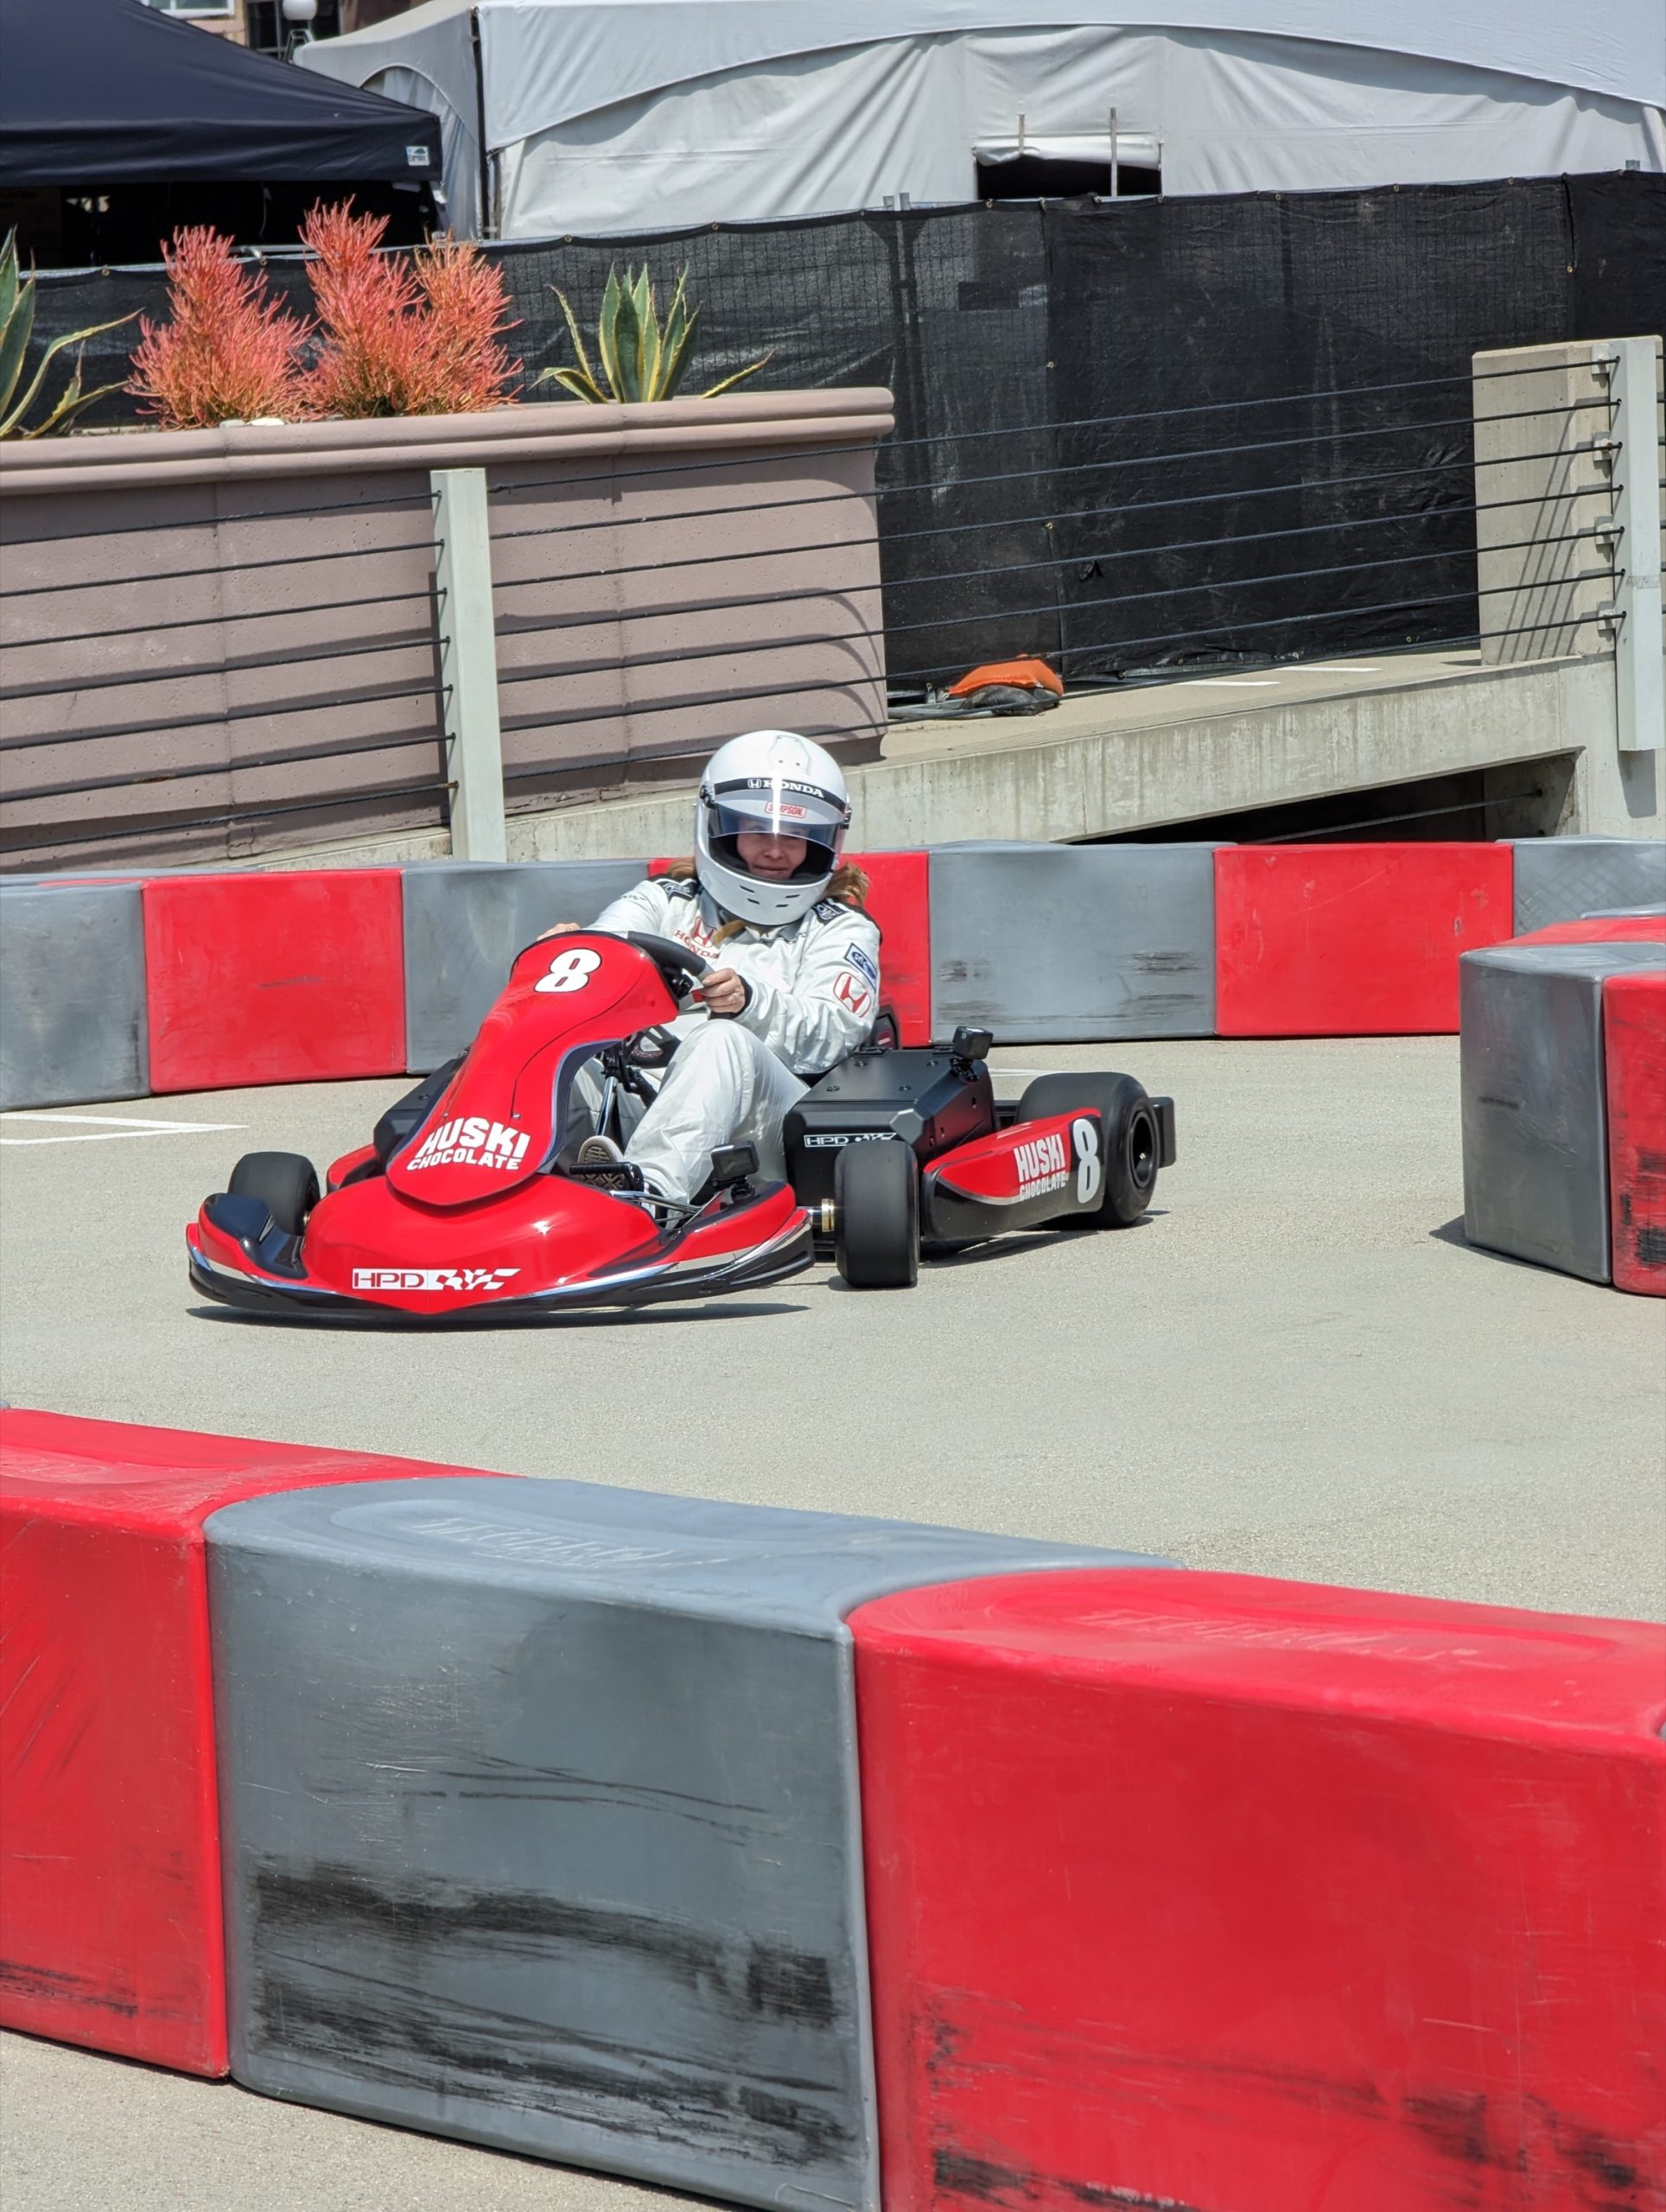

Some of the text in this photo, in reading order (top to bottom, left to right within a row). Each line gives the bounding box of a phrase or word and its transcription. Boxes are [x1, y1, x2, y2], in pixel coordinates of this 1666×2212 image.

[768, 804, 803, 816] SMPSON
[533, 947, 602, 994] 8
[414, 1117, 531, 1159] HUSKI
[805, 1136, 849, 1146] HPD
[406, 1147, 522, 1171] CHOCOLATE
[1014, 1134, 1065, 1183] HUSKI
[1072, 1118, 1100, 1204] 8
[1020, 1172, 1067, 1201] CHOCOLATE
[354, 1272, 425, 1288] HPD
